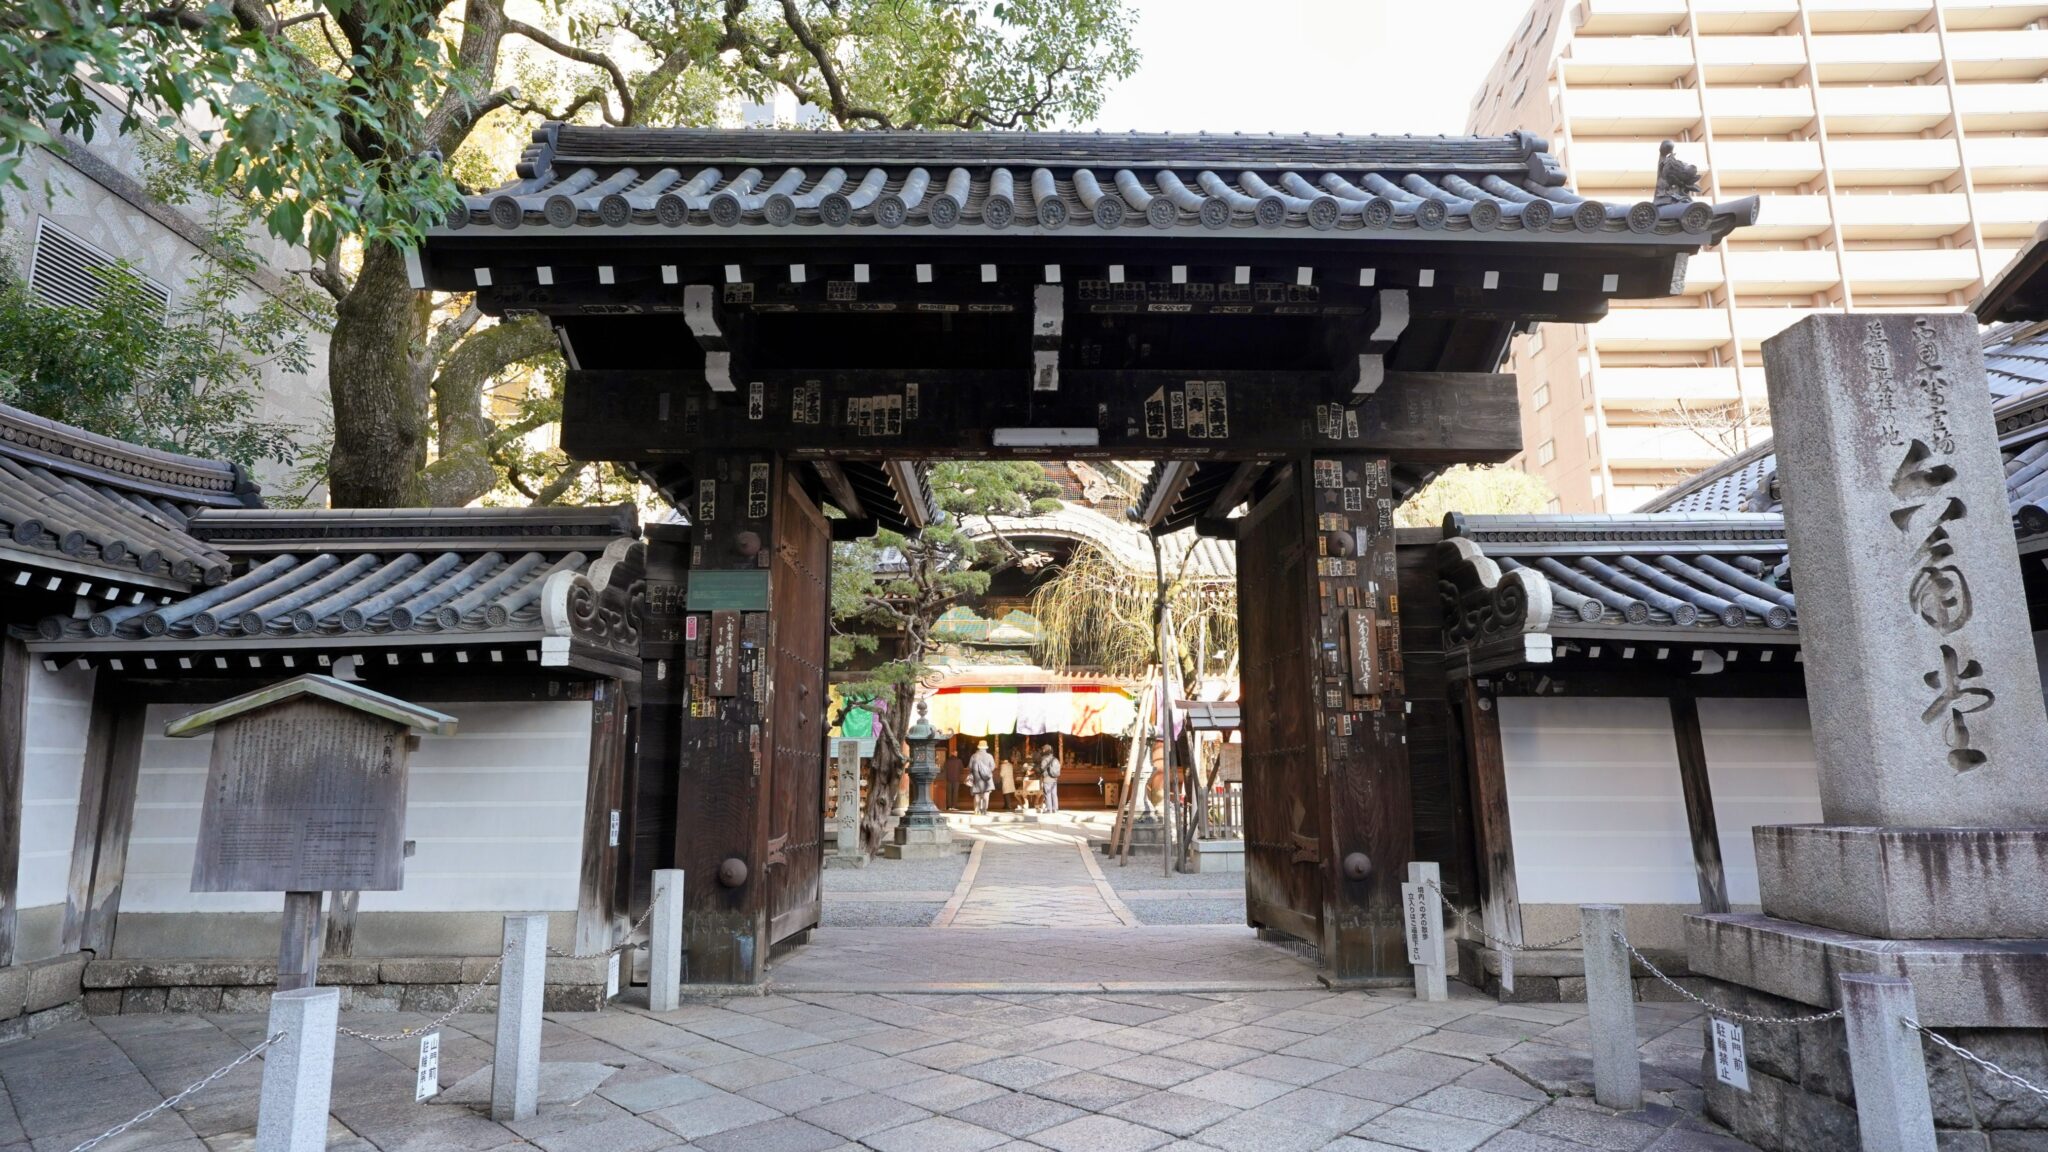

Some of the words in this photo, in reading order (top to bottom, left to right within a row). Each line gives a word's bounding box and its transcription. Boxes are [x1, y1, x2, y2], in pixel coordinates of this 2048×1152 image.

[1716, 1022, 1731, 1080] 駐輪禁止
[1730, 1029, 1744, 1072] 山門前
